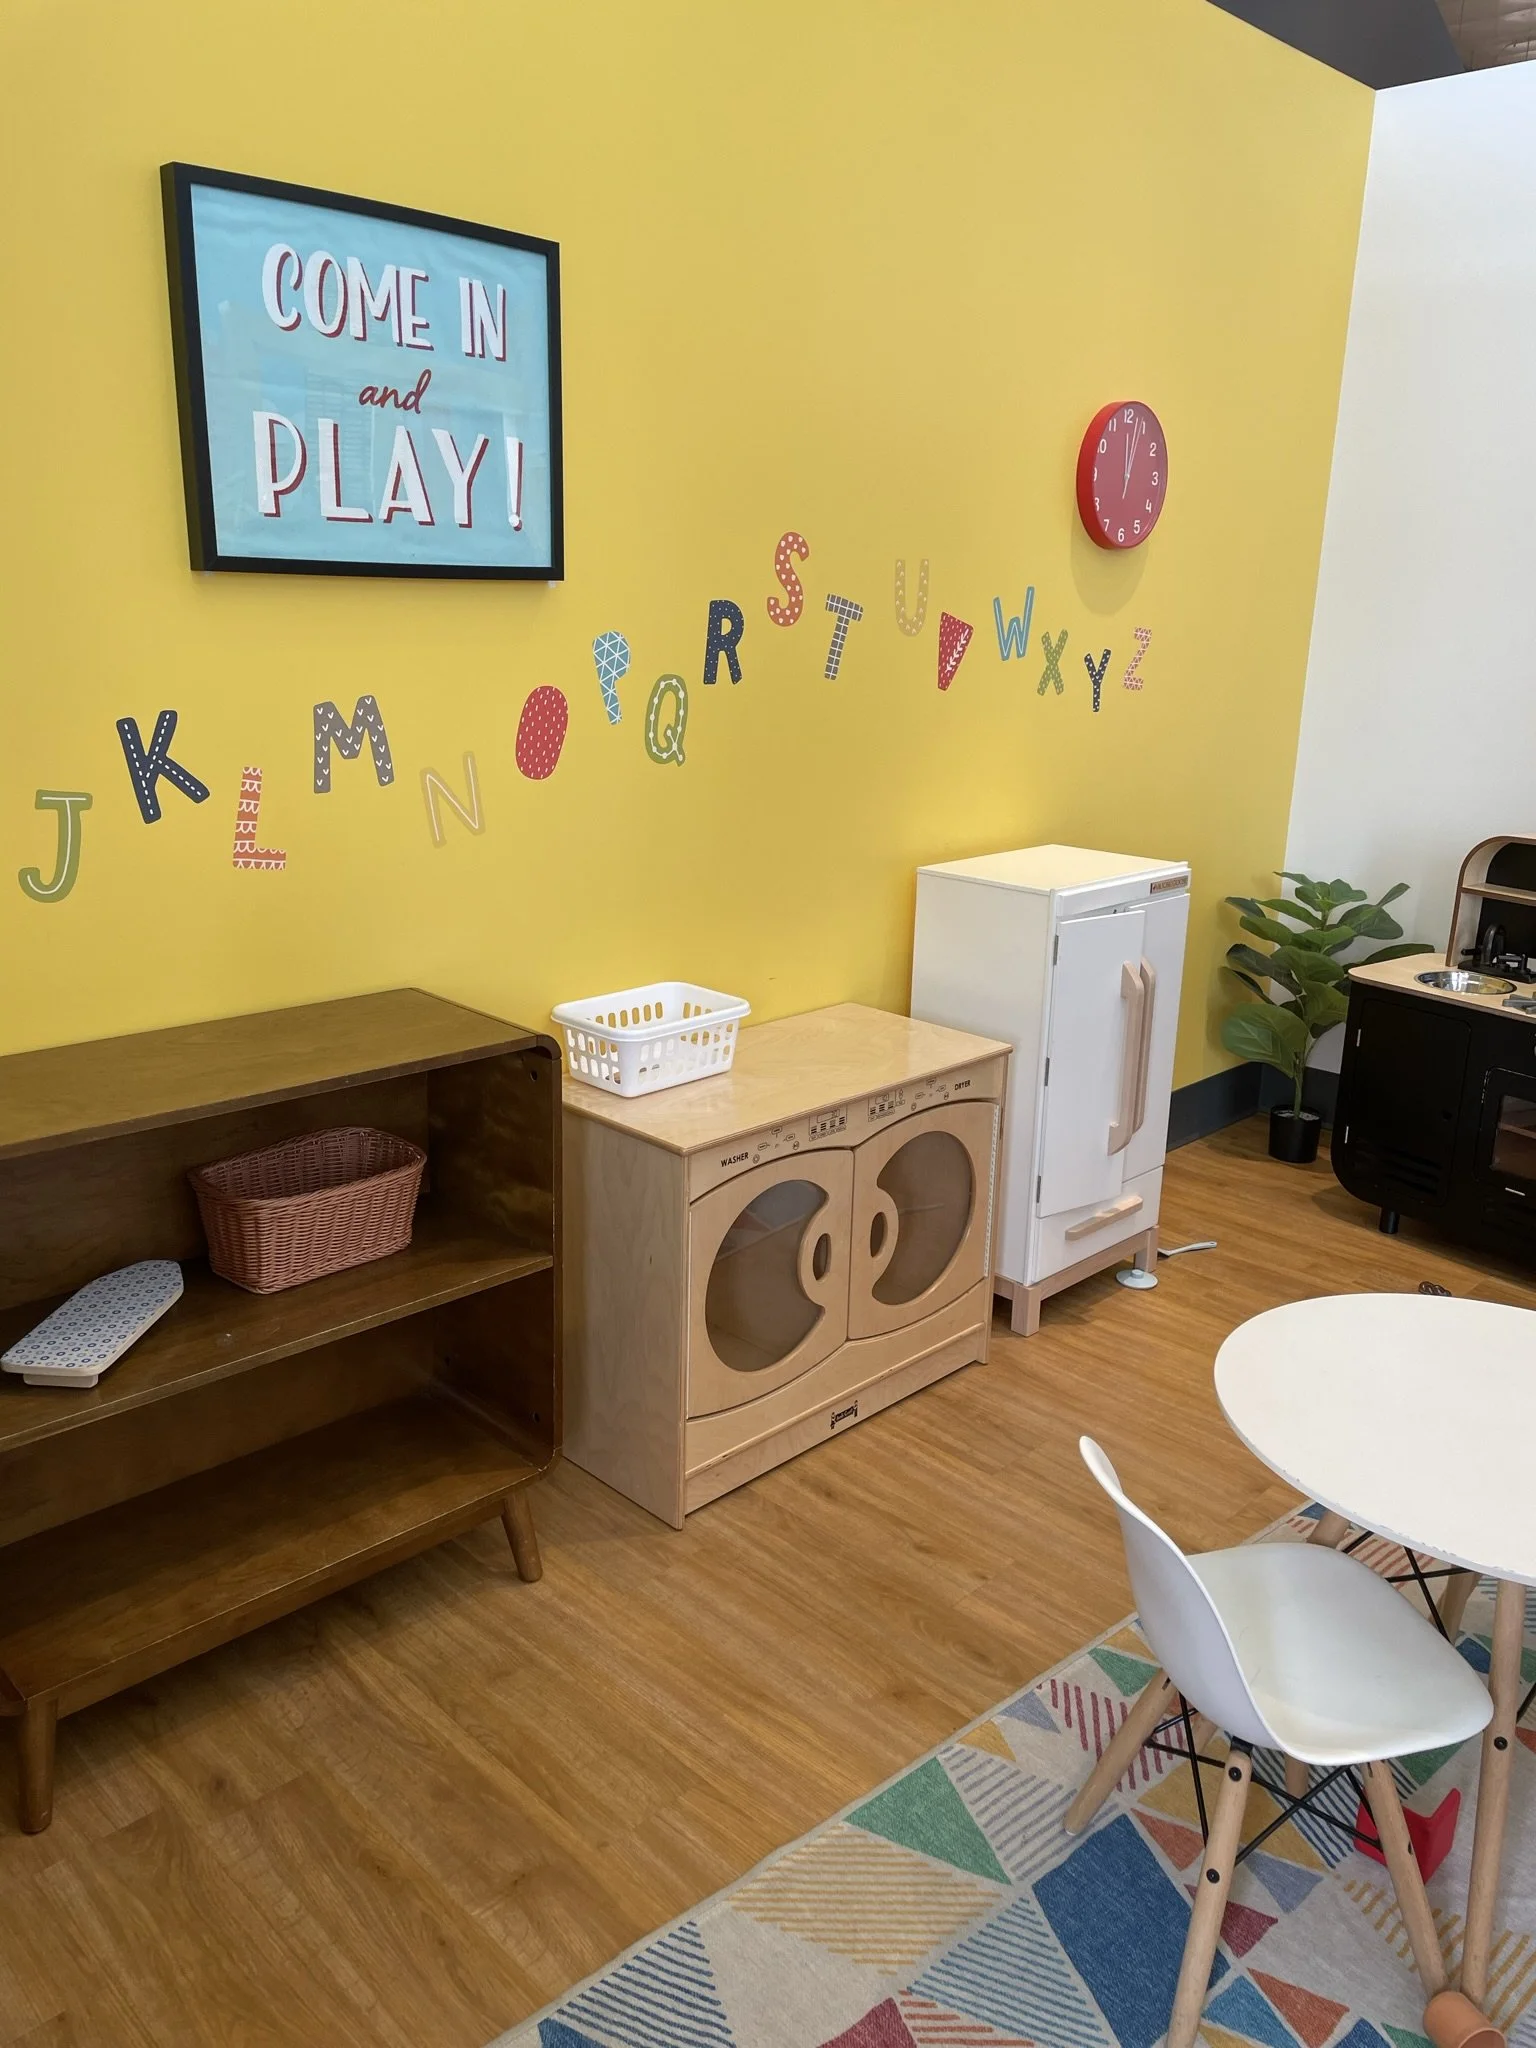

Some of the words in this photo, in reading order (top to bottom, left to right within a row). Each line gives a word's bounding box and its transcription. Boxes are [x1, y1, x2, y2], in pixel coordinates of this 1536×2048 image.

[262, 243, 435, 351] COME
[459, 276, 508, 362] IN
[358, 369, 432, 415] and
[1124, 408, 1134, 424] 12
[1108, 418, 1117, 432] 11
[1149, 443, 1157, 457] 2
[252, 411, 525, 532] PLAY!
[1151, 471, 1159, 486] 3
[1145, 499, 1152, 513] 4
[1103, 518, 1110, 532] 7
[1133, 519, 1141, 534] 5
[1117, 528, 1125, 542] 6
[18, 789, 92, 903] J
[116, 709, 210, 825] K
[232, 767, 287, 871] L
[313, 694, 395, 794] M
[420, 751, 485, 848] N
[592, 630, 631, 725] P
[645, 674, 688, 766] Q
[703, 599, 745, 686] R
[767, 531, 810, 627] S
[824, 594, 864, 680] T
[895, 558, 930, 637] U
[993, 586, 1035, 661] W
[1037, 629, 1068, 696] X
[1084, 648, 1112, 713] Y
[1122, 627, 1152, 691] Z
[954, 1079, 971, 1091] DRYER
[720, 1151, 749, 1168] WASHER
